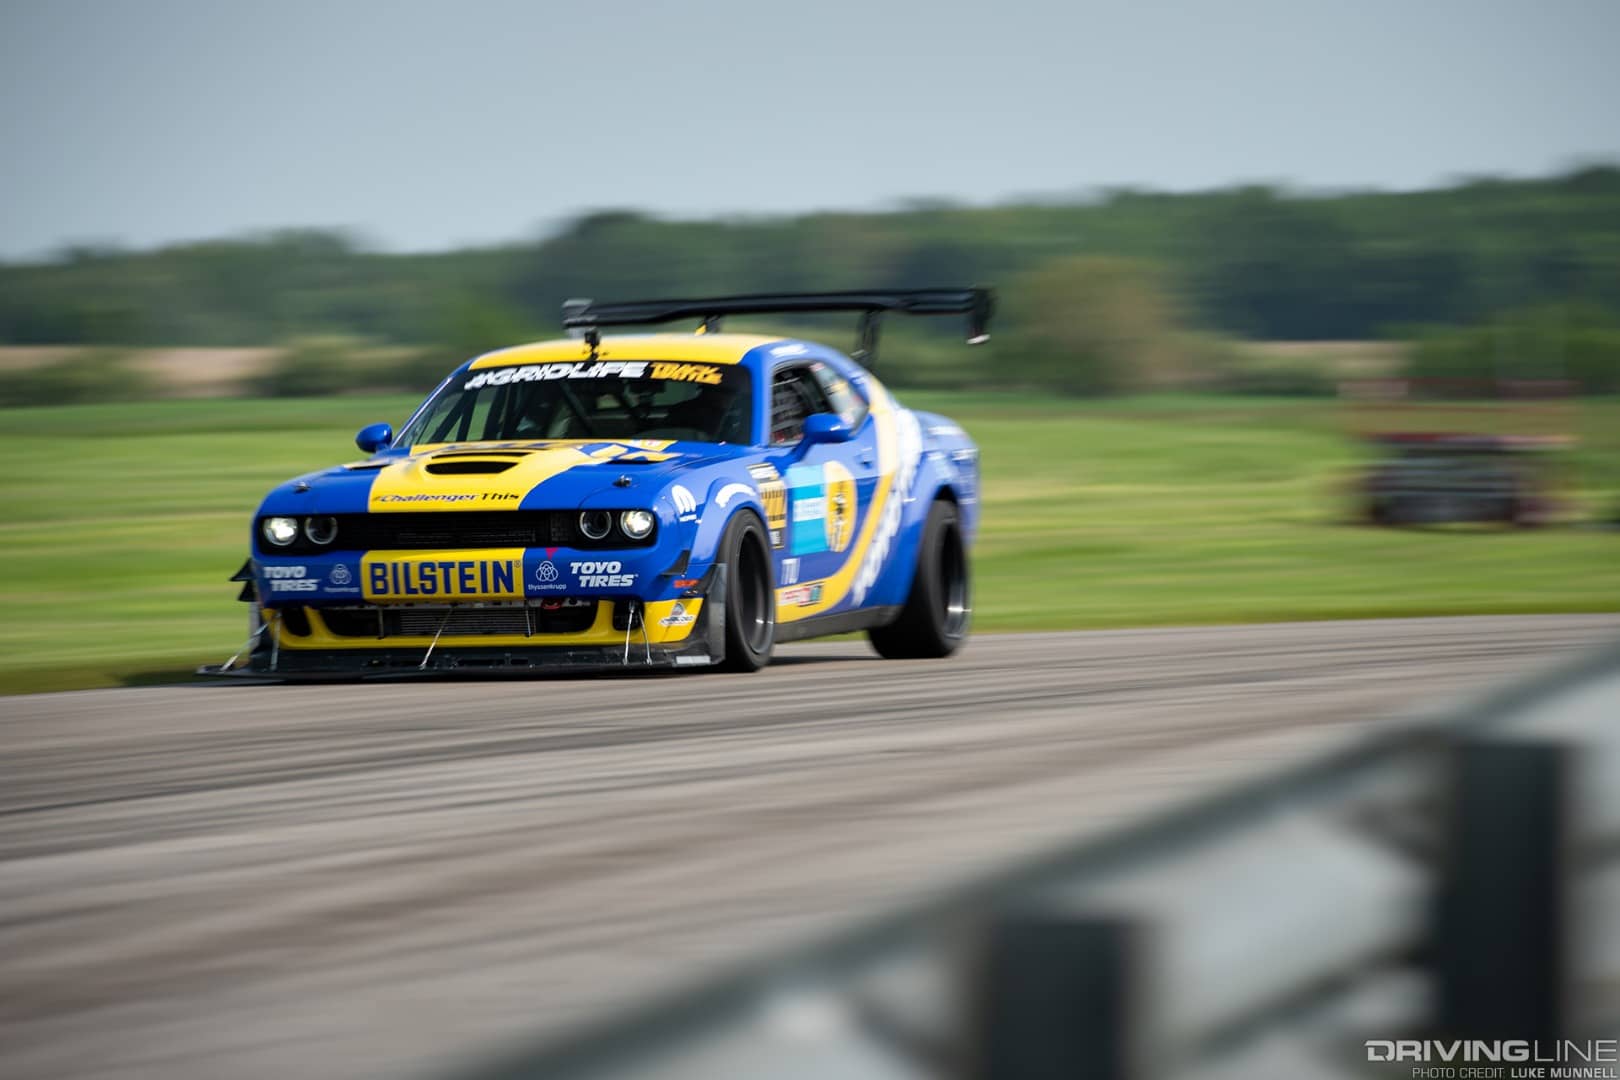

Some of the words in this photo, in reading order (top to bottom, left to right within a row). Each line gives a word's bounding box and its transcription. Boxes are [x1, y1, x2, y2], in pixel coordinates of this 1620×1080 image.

[482, 492, 518, 501] This
[264, 566, 307, 579] TOYO
[570, 561, 622, 575] TOYO
[579, 574, 635, 588] TIRES
